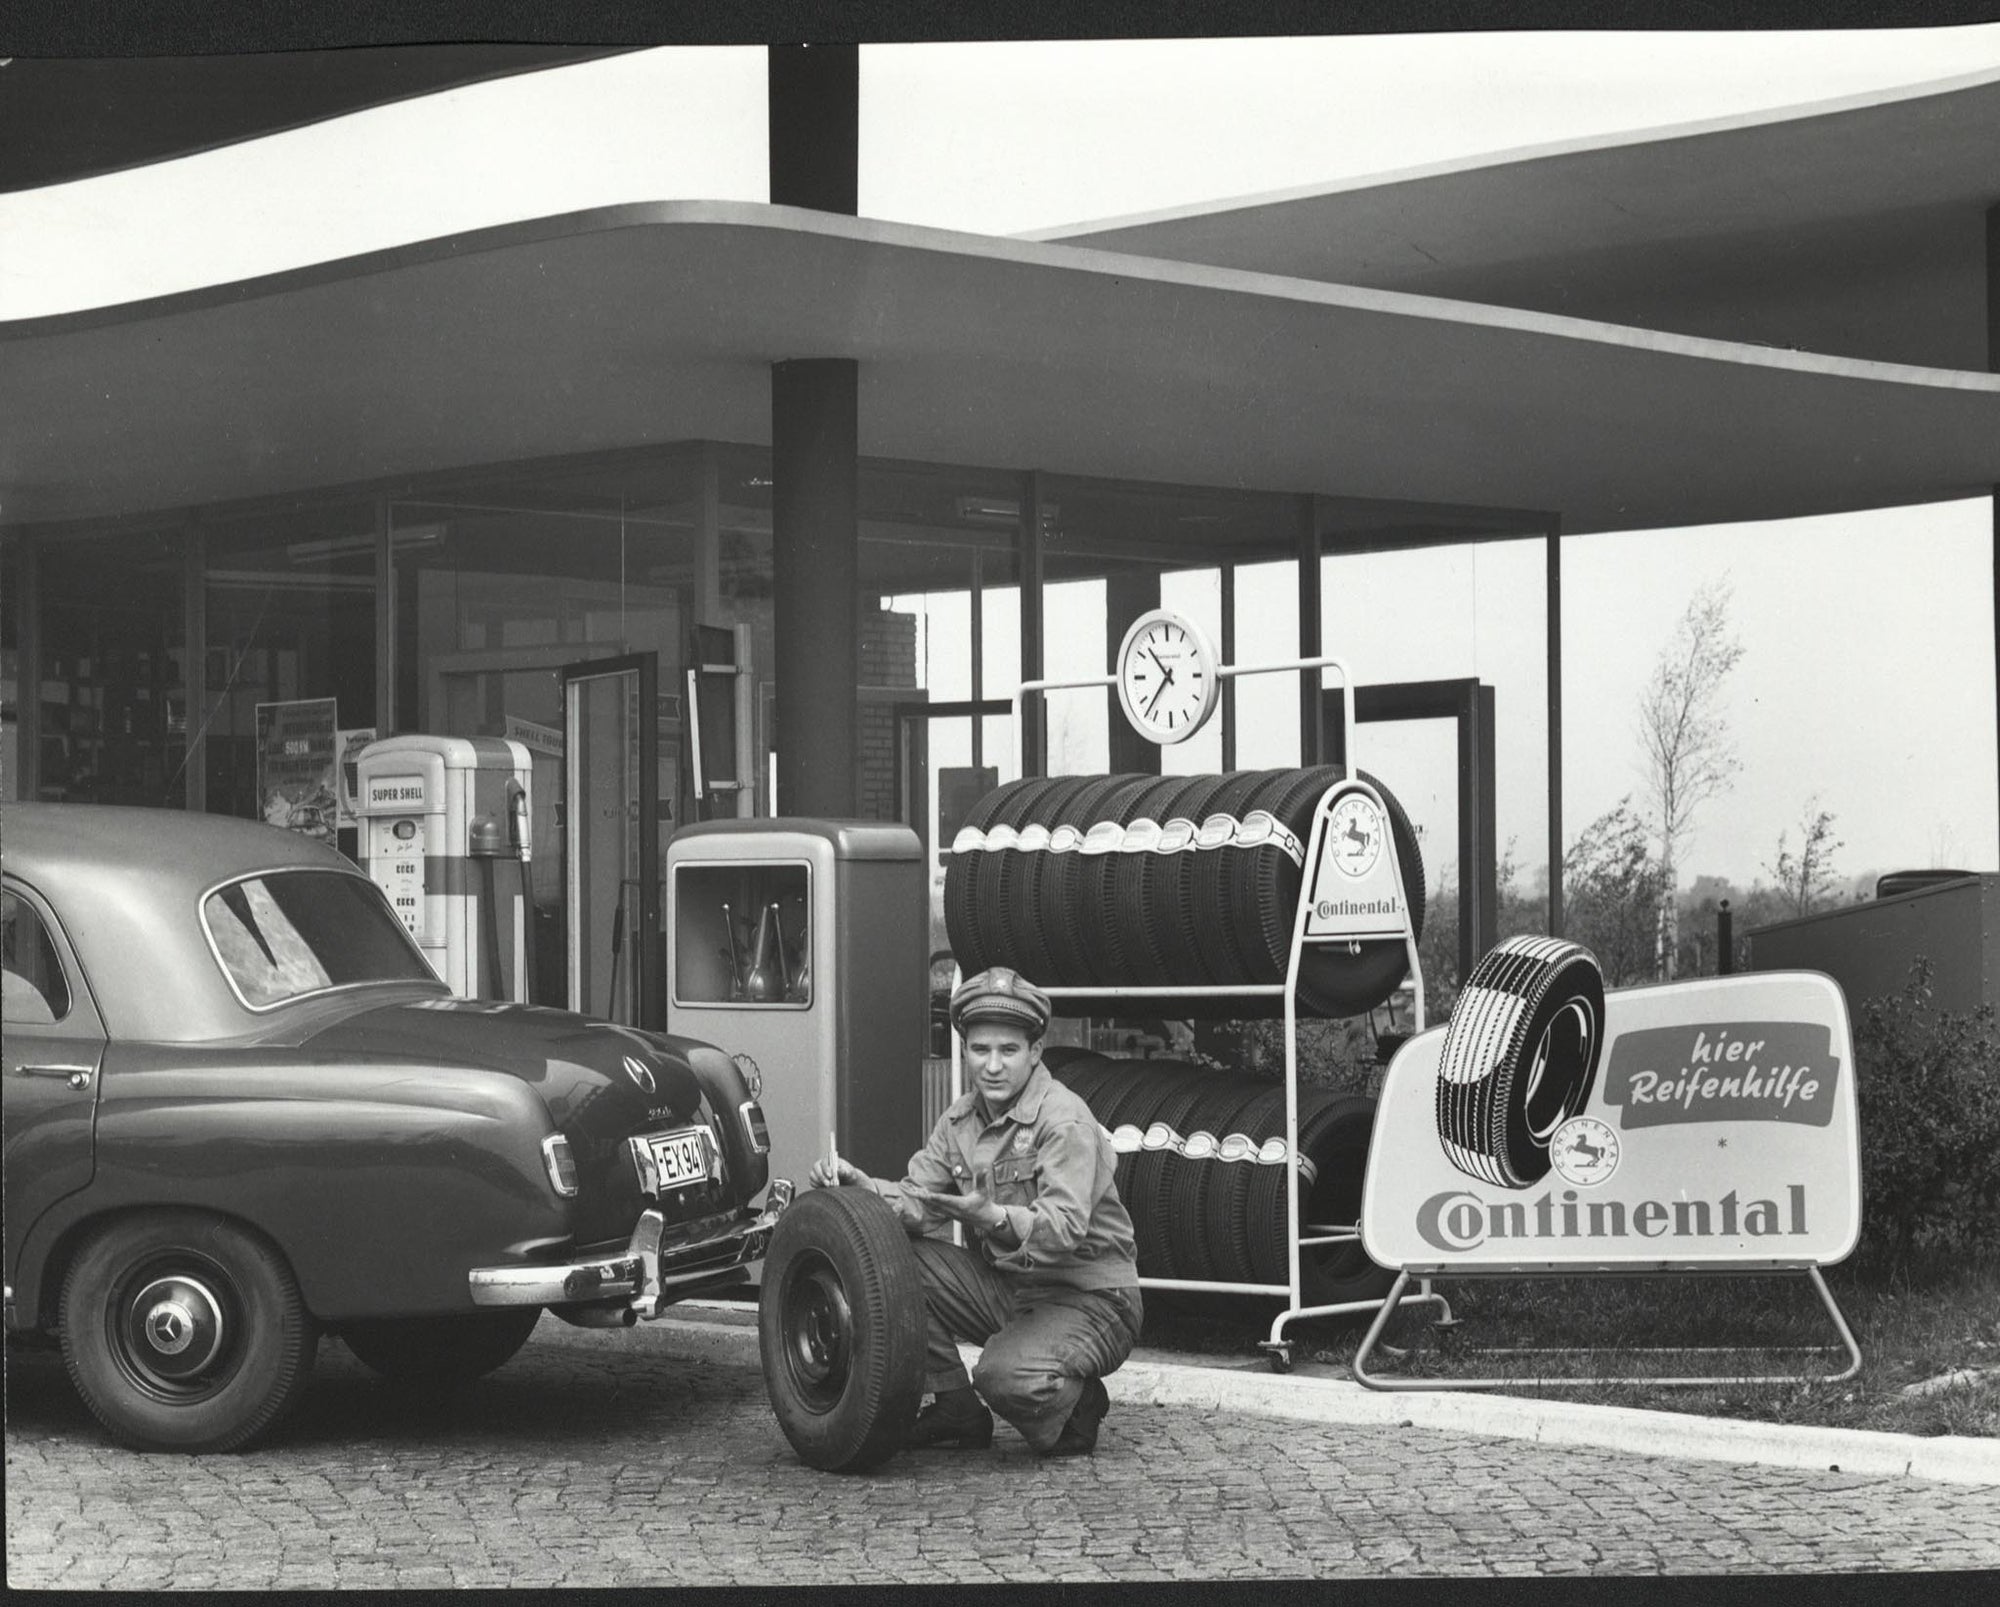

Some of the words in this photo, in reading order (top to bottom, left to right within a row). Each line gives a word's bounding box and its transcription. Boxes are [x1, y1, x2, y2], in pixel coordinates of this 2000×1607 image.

[372, 788, 398, 801] SUPER
[400, 787, 423, 800] SHELL
[1333, 803, 1379, 858] CONTINENTAL
[1316, 897, 1396, 919] Continental
[1691, 1030, 1765, 1063] hier
[1628, 1065, 1820, 1109] Reifenhilfe
[1554, 1121, 1617, 1169] CONTINENTAL
[1415, 1184, 1810, 1253] Continental
